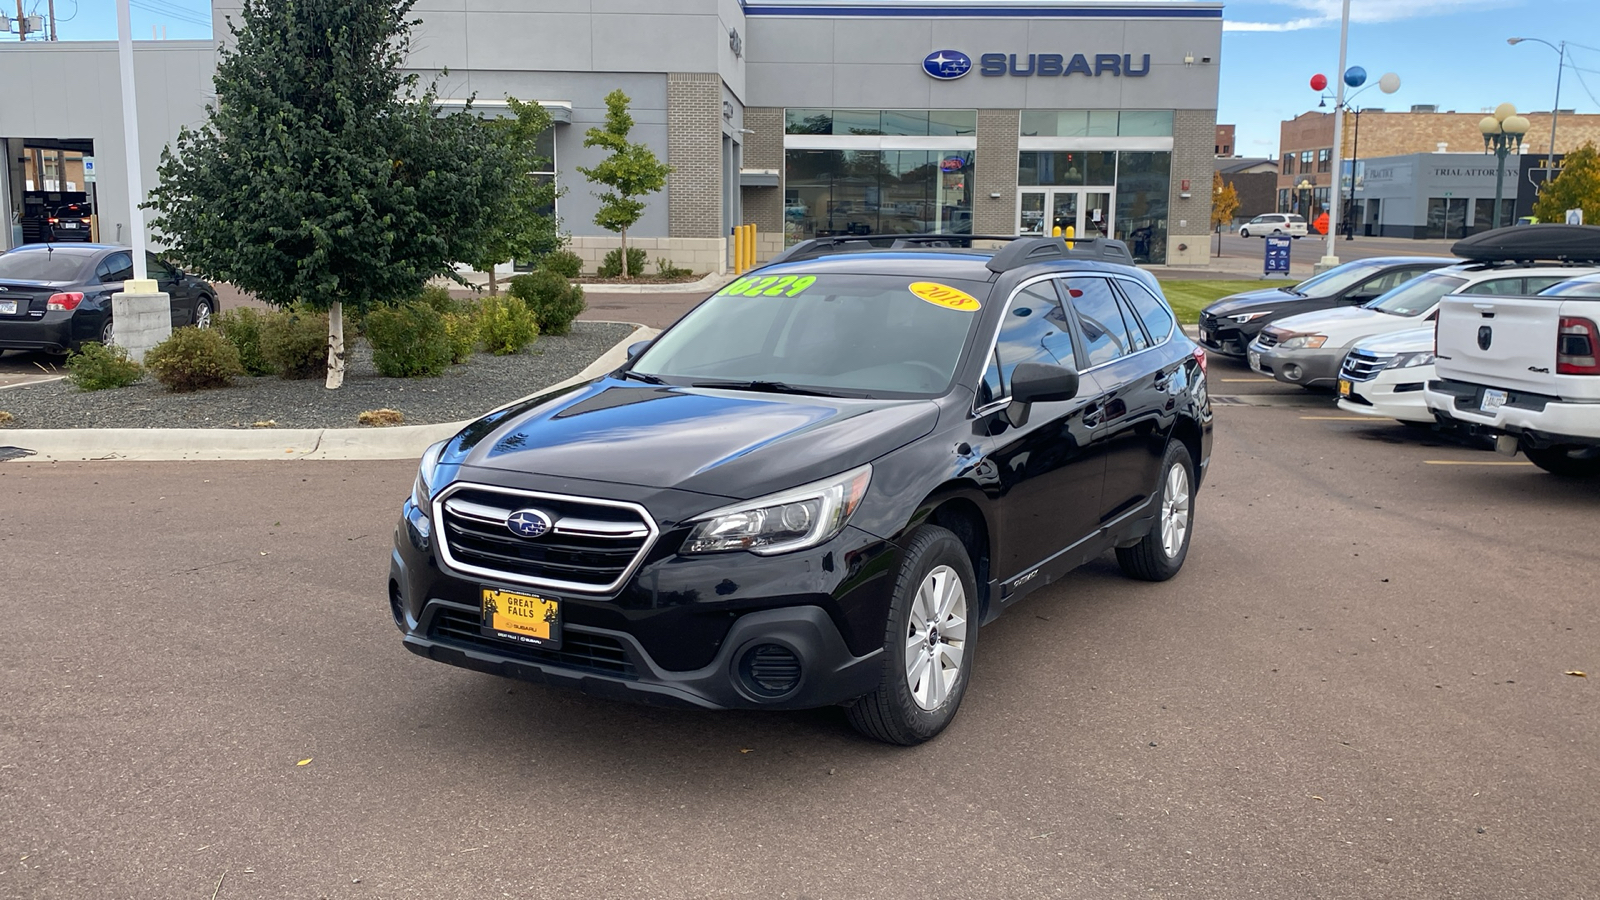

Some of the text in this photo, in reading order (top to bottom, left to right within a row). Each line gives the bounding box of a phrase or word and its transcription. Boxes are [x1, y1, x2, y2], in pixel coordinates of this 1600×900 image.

[980, 53, 1151, 77] SUBARU
[940, 159, 962, 169] OPEN
[1434, 168, 1462, 177] TRIAL
[716, 275, 817, 297] 16229
[916, 286, 972, 306] 2018
[507, 597, 534, 608] GREAT
[508, 606, 534, 618] FALLS
[513, 624, 538, 632] SUBARU
